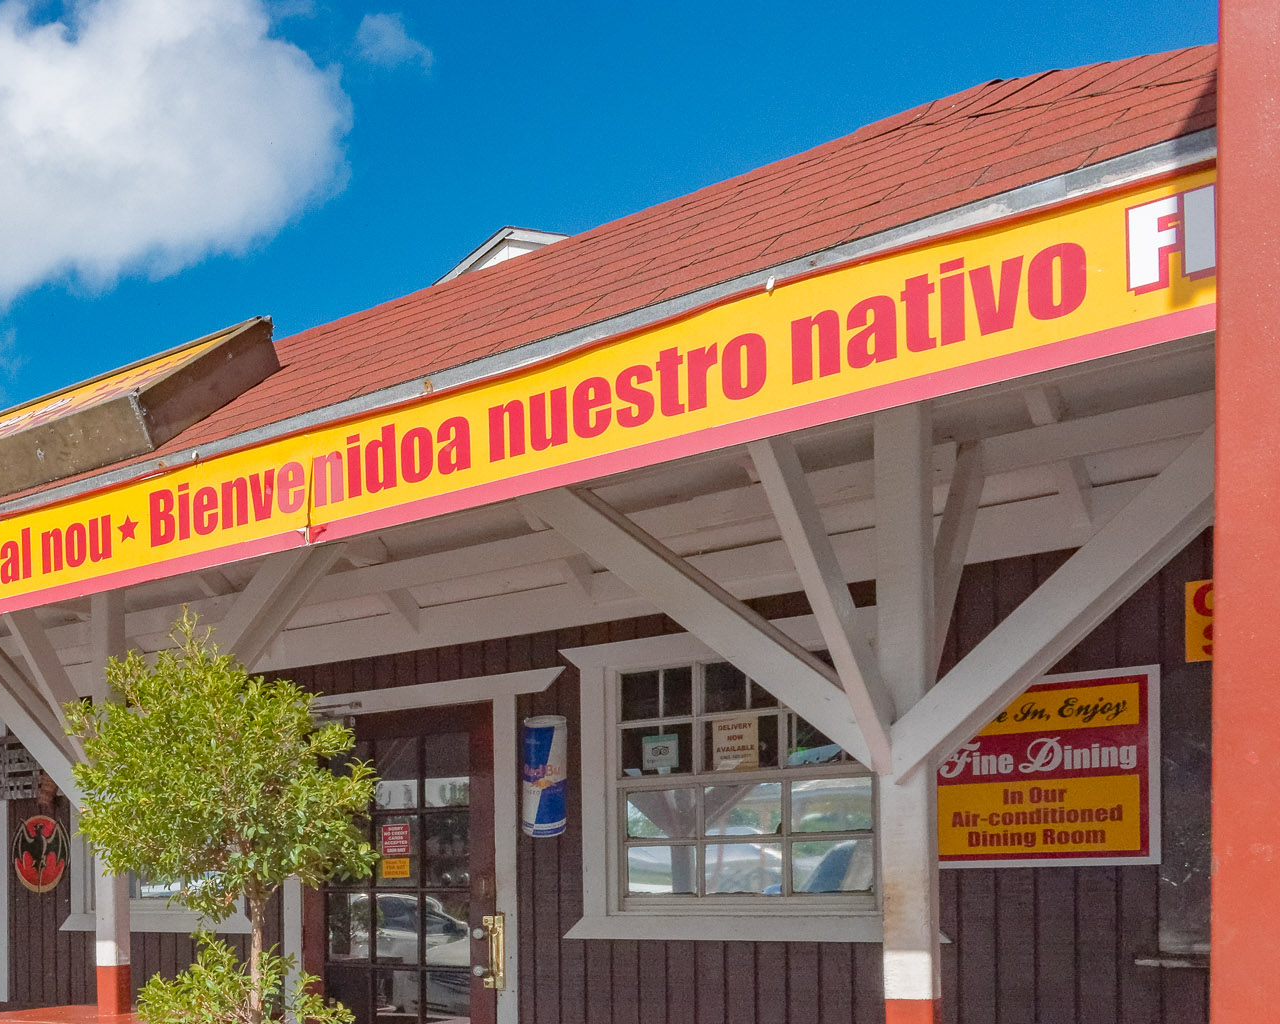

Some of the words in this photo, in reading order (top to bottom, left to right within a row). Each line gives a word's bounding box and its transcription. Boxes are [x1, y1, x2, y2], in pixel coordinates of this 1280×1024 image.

[40, 514, 112, 573] nou
[149, 416, 472, 549] Bienvenidoa
[488, 332, 768, 463] nuestro
[790, 243, 1087, 386] nativo
[1057, 697, 1128, 724] Enjoy
[718, 722, 752, 731] DELIVERY
[717, 744, 754, 752] AVAILABLE
[939, 741, 1014, 779] Fine
[1018, 736, 1137, 774] Dining
[1003, 788, 1023, 804] In
[1029, 786, 1067, 803] Our
[952, 805, 1123, 828] Air-conditioned
[967, 829, 1036, 848] Dining
[1043, 829, 1106, 844] Room
